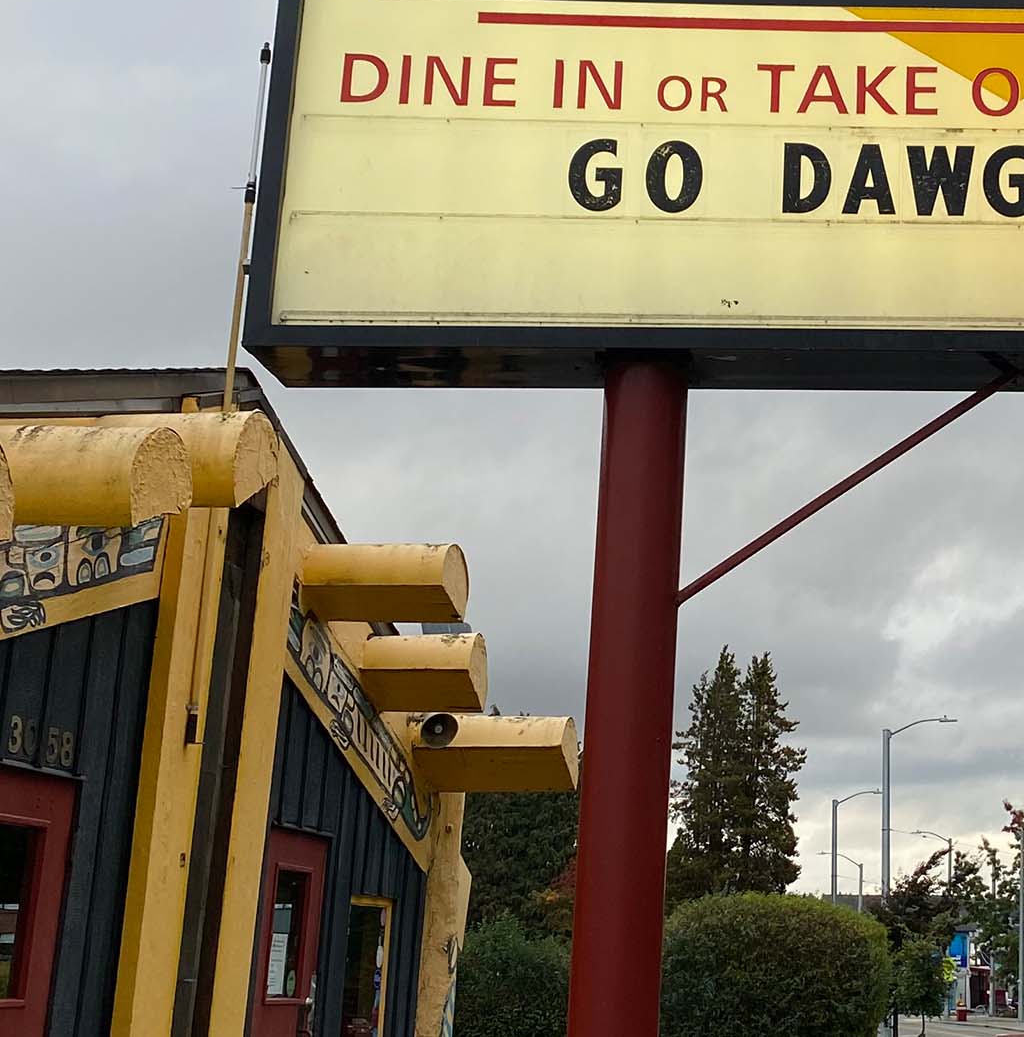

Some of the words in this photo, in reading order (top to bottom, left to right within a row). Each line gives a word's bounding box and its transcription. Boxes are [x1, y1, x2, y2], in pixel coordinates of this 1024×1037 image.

[341, 53, 518, 107] DINE
[553, 59, 623, 110] IN
[657, 76, 728, 111] OR
[757, 64, 937, 116] TAKE
[568, 138, 703, 214] GO
